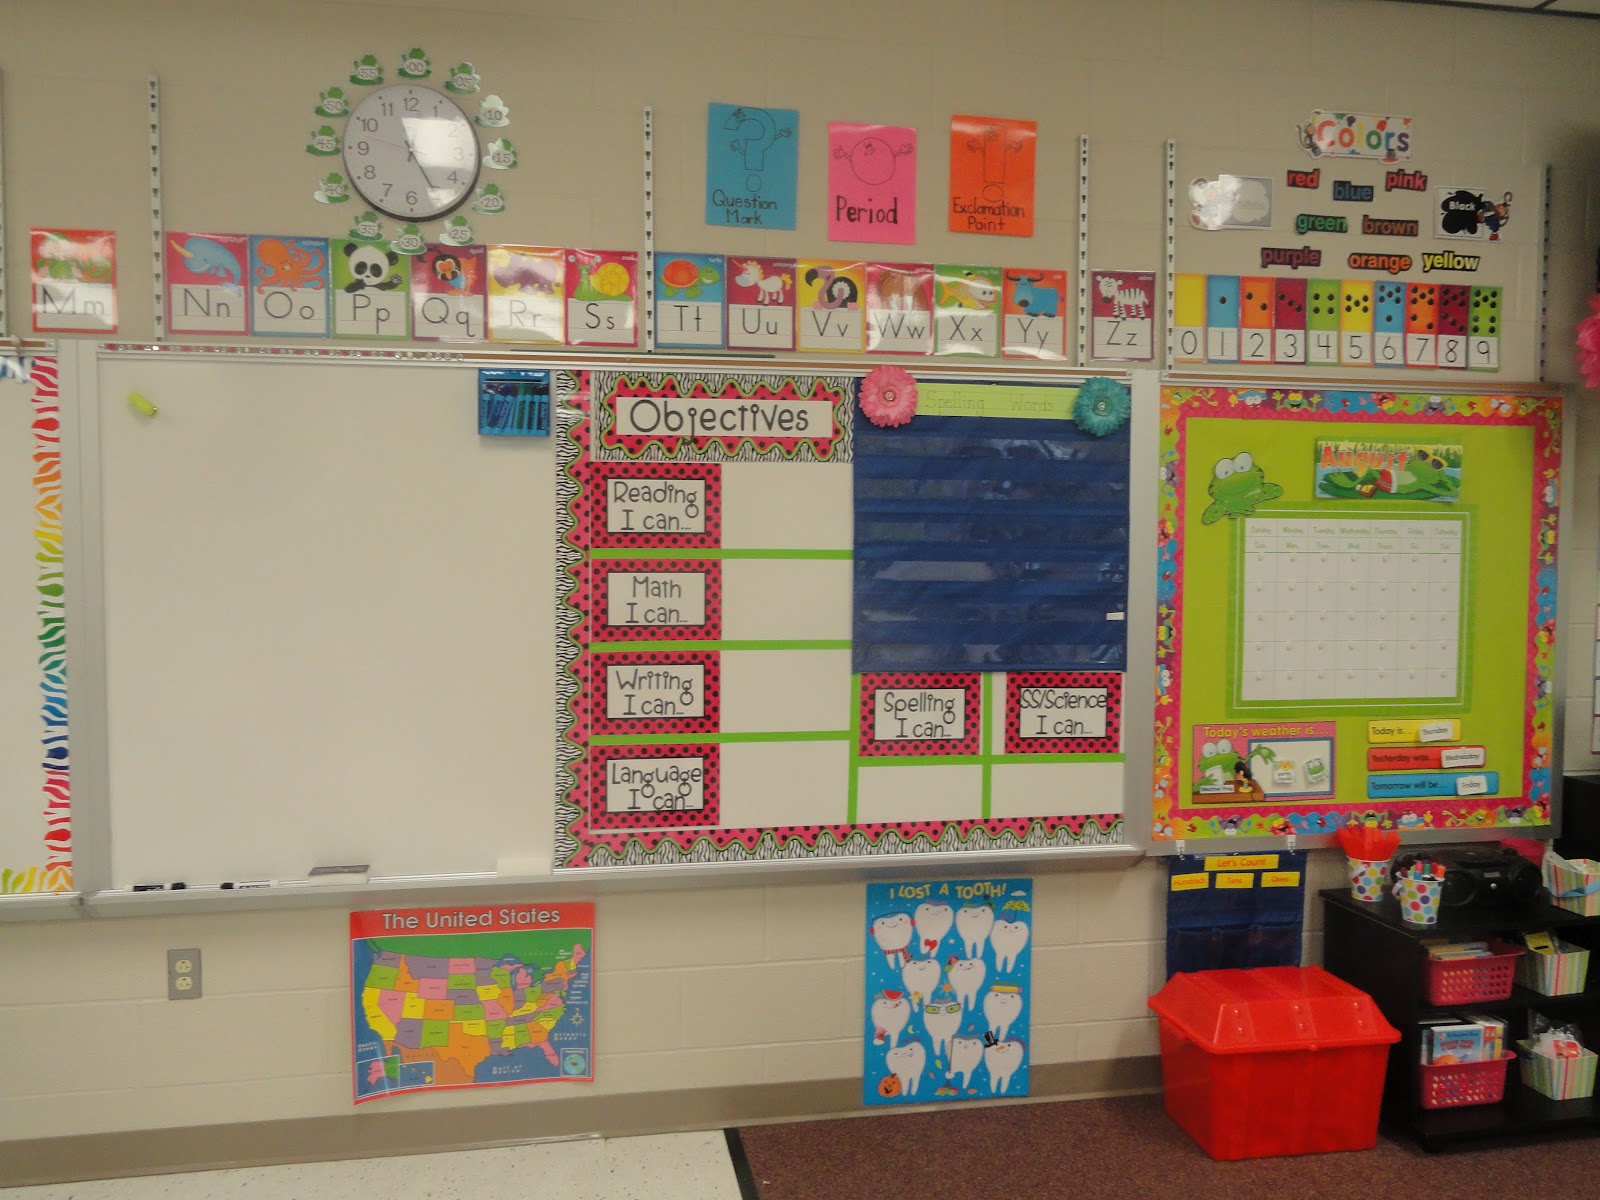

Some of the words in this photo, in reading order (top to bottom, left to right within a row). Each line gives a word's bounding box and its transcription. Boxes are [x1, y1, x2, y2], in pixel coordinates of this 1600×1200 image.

[382, 103, 394, 116] 11
[403, 97, 420, 112] 12
[432, 105, 438, 117] 1
[361, 118, 378, 133] 10
[1316, 119, 1410, 153] Colors
[357, 141, 370, 156] 9
[455, 147, 465, 161] 3
[363, 165, 376, 180] 8
[447, 170, 459, 184] 4
[1288, 169, 1320, 190] red
[1386, 169, 1428, 192] pink
[381, 183, 393, 198] 7
[406, 190, 418, 206] 6
[712, 189, 778, 211] Question
[1333, 181, 1374, 202] blue
[836, 195, 899, 226] Period
[952, 196, 1026, 219] Exclamation
[1449, 199, 1477, 212] Black
[726, 208, 763, 226] Mark
[967, 215, 1006, 232] Point
[1296, 213, 1348, 235] green
[1362, 215, 1419, 237] brown
[1260, 246, 1322, 269] purple
[1348, 253, 1412, 275] orange
[1422, 251, 1480, 273] yellow
[1181, 331, 1198, 355] 0
[1220, 331, 1226, 356] 1
[1249, 333, 1265, 358] 2
[1283, 334, 1298, 358] 3
[1316, 335, 1331, 359] 4
[1349, 336, 1363, 360] 5
[1382, 337, 1396, 360] 6
[1415, 338, 1430, 361] 7
[1444, 339, 1459, 363] 8
[1476, 341, 1491, 365] 9
[925, 390, 985, 415] Spelling
[1009, 393, 1055, 412] Words
[629, 399, 809, 439] Objectives
[1320, 445, 1408, 477] August
[614, 480, 700, 518] Reading
[620, 509, 634, 530] I
[633, 576, 682, 598] Math
[625, 602, 639, 624] I
[616, 669, 694, 706] Writing
[623, 694, 637, 716] I
[884, 691, 956, 724] Spelling
[1020, 689, 1107, 710] SS/Science
[896, 718, 908, 738] I
[1036, 715, 1048, 735] I
[1204, 726, 1248, 740] Today's
[1252, 725, 1302, 737] weather
[1371, 726, 1395, 737] Today
[1371, 754, 1411, 763] Yesterday
[612, 763, 702, 798] Language
[1371, 781, 1411, 790] Tomorrow
[1414, 780, 1426, 789] will
[627, 789, 641, 810] I
[1239, 857, 1267, 868] Count
[889, 887, 895, 900] I
[898, 883, 931, 900] LOST
[938, 882, 949, 896] A
[955, 881, 1007, 900] TOOTH!
[382, 912, 419, 930] The
[426, 909, 493, 929] United
[499, 907, 561, 925] States
